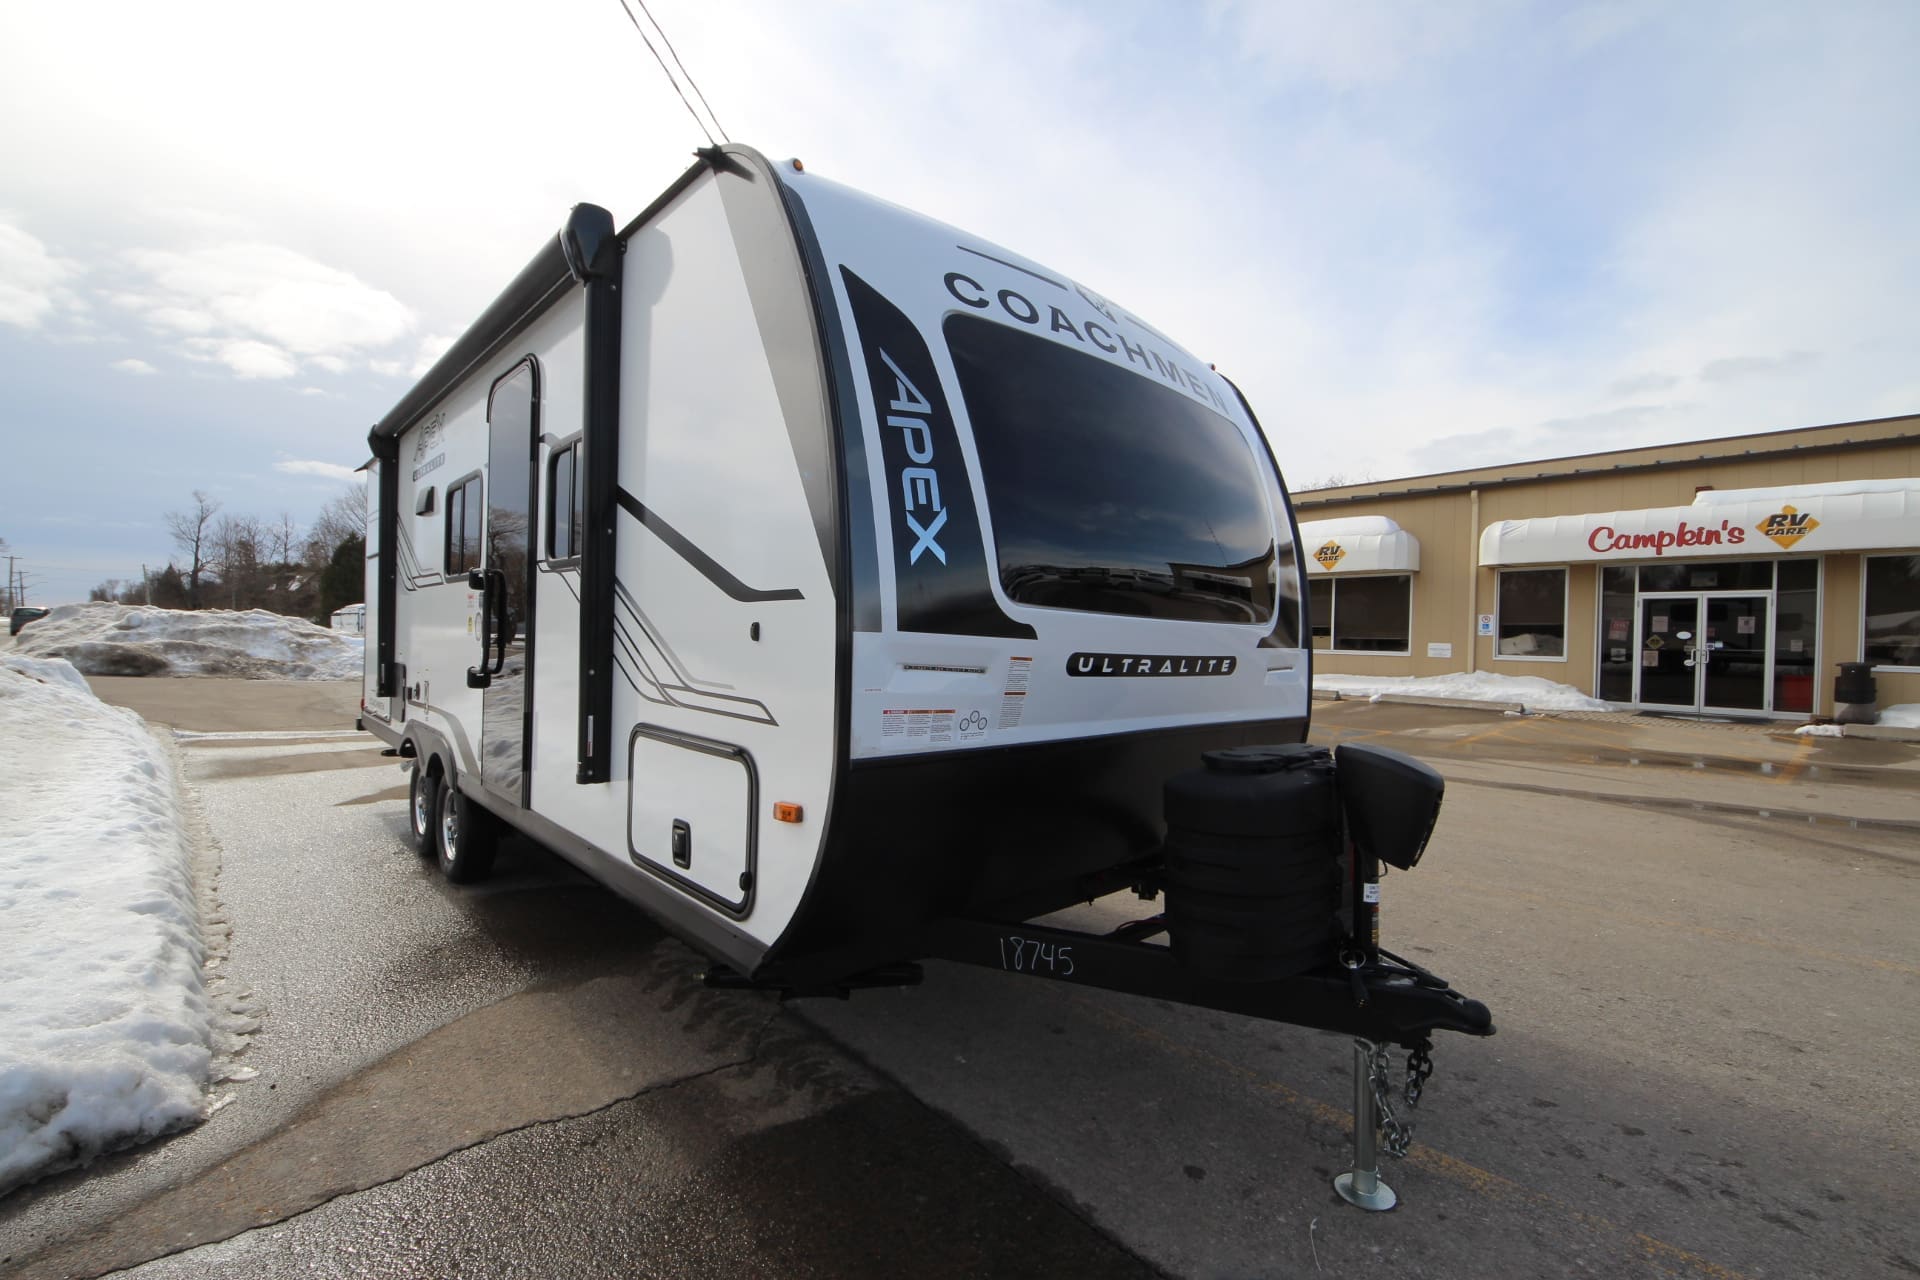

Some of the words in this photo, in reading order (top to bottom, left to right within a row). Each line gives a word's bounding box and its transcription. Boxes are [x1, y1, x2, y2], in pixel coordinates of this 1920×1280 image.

[943, 271, 1230, 416] COACHMEN
[878, 347, 947, 567] APEX
[1765, 527, 1808, 536] CARE
[1767, 513, 1810, 527] RV
[1319, 545, 1341, 556] RV
[1588, 519, 1745, 556] Campkin's
[1078, 655, 1232, 673] ULTRALITE
[1000, 937, 1074, 976] 18745
